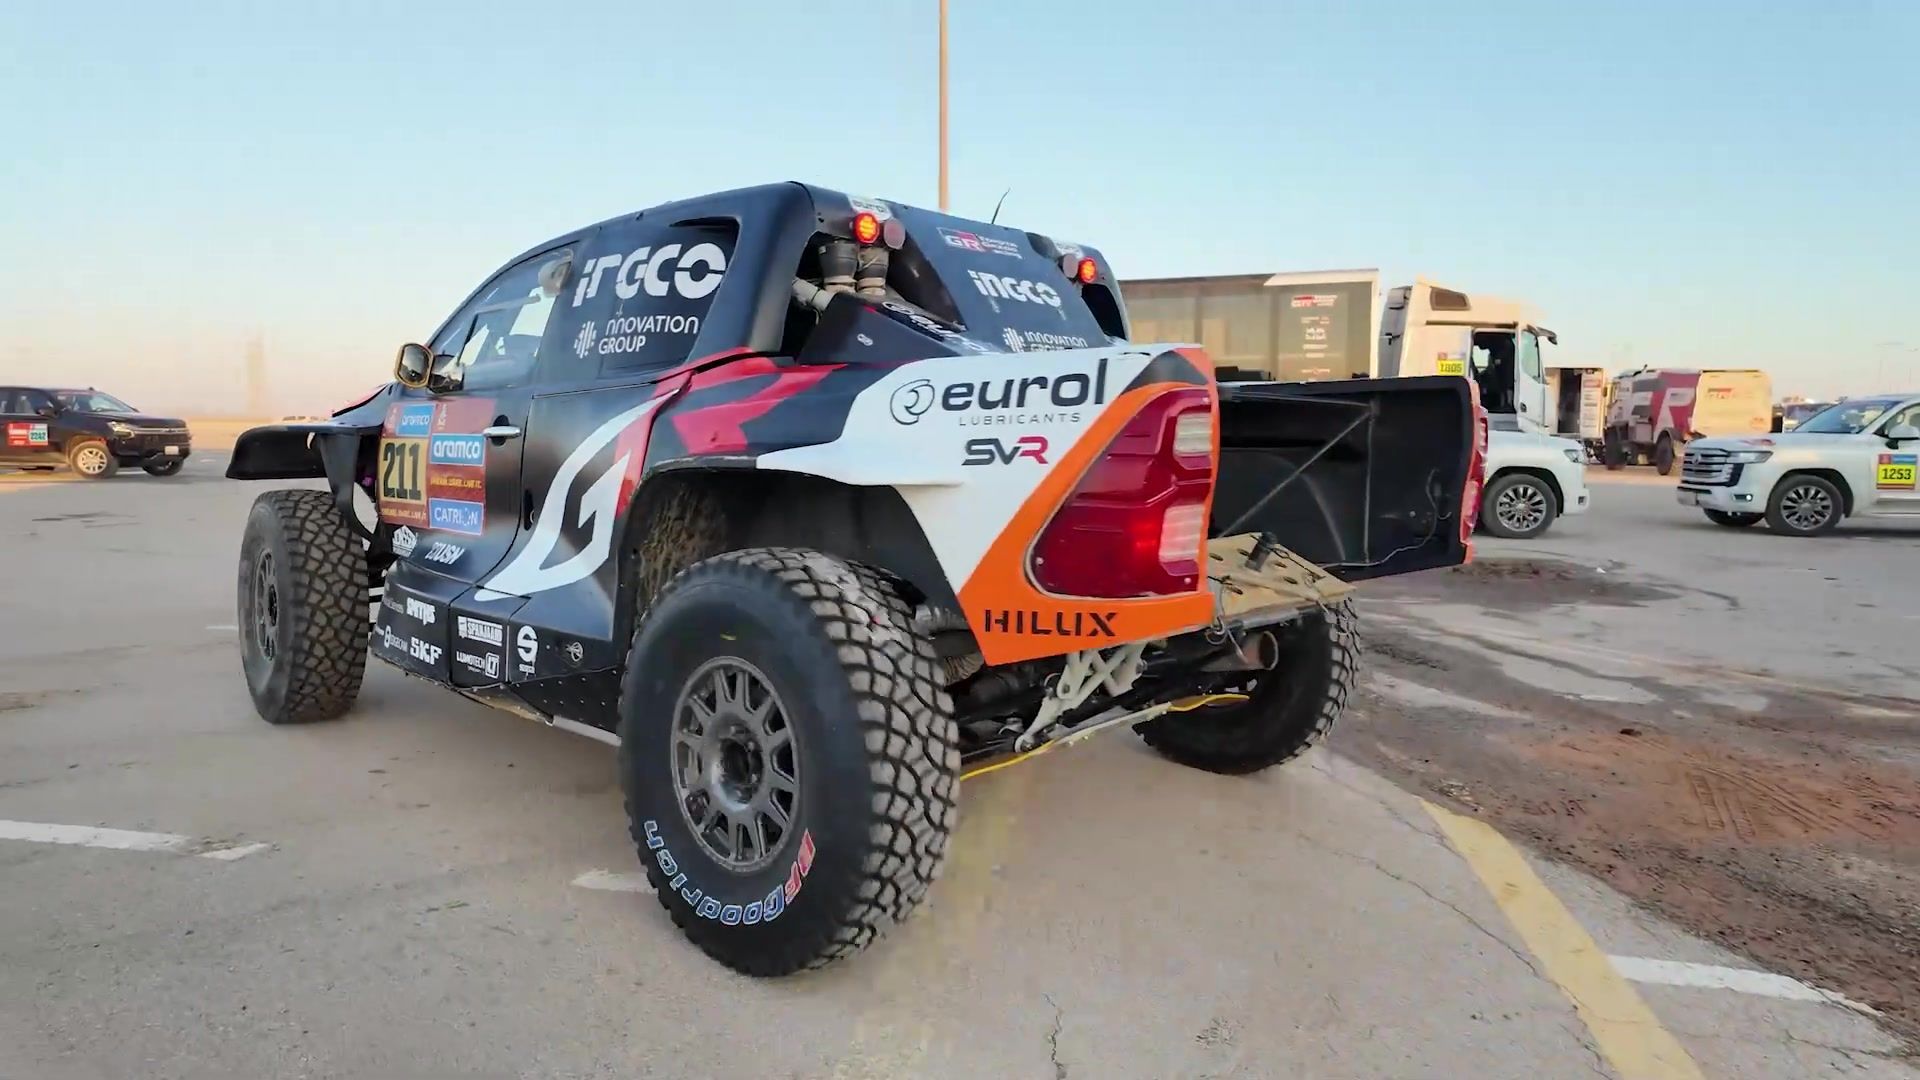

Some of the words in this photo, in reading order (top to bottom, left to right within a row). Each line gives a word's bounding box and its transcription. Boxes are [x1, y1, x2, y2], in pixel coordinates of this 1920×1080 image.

[598, 335, 646, 354] GROUP
[941, 359, 1108, 411] eurol
[959, 412, 1081, 427] LUBRICANTS
[433, 440, 481, 459] aramco
[962, 436, 1049, 466] SVR
[383, 442, 422, 500] 211
[1881, 468, 1912, 480] 1253
[985, 610, 1120, 637] HILUX
[410, 636, 443, 665] SKF
